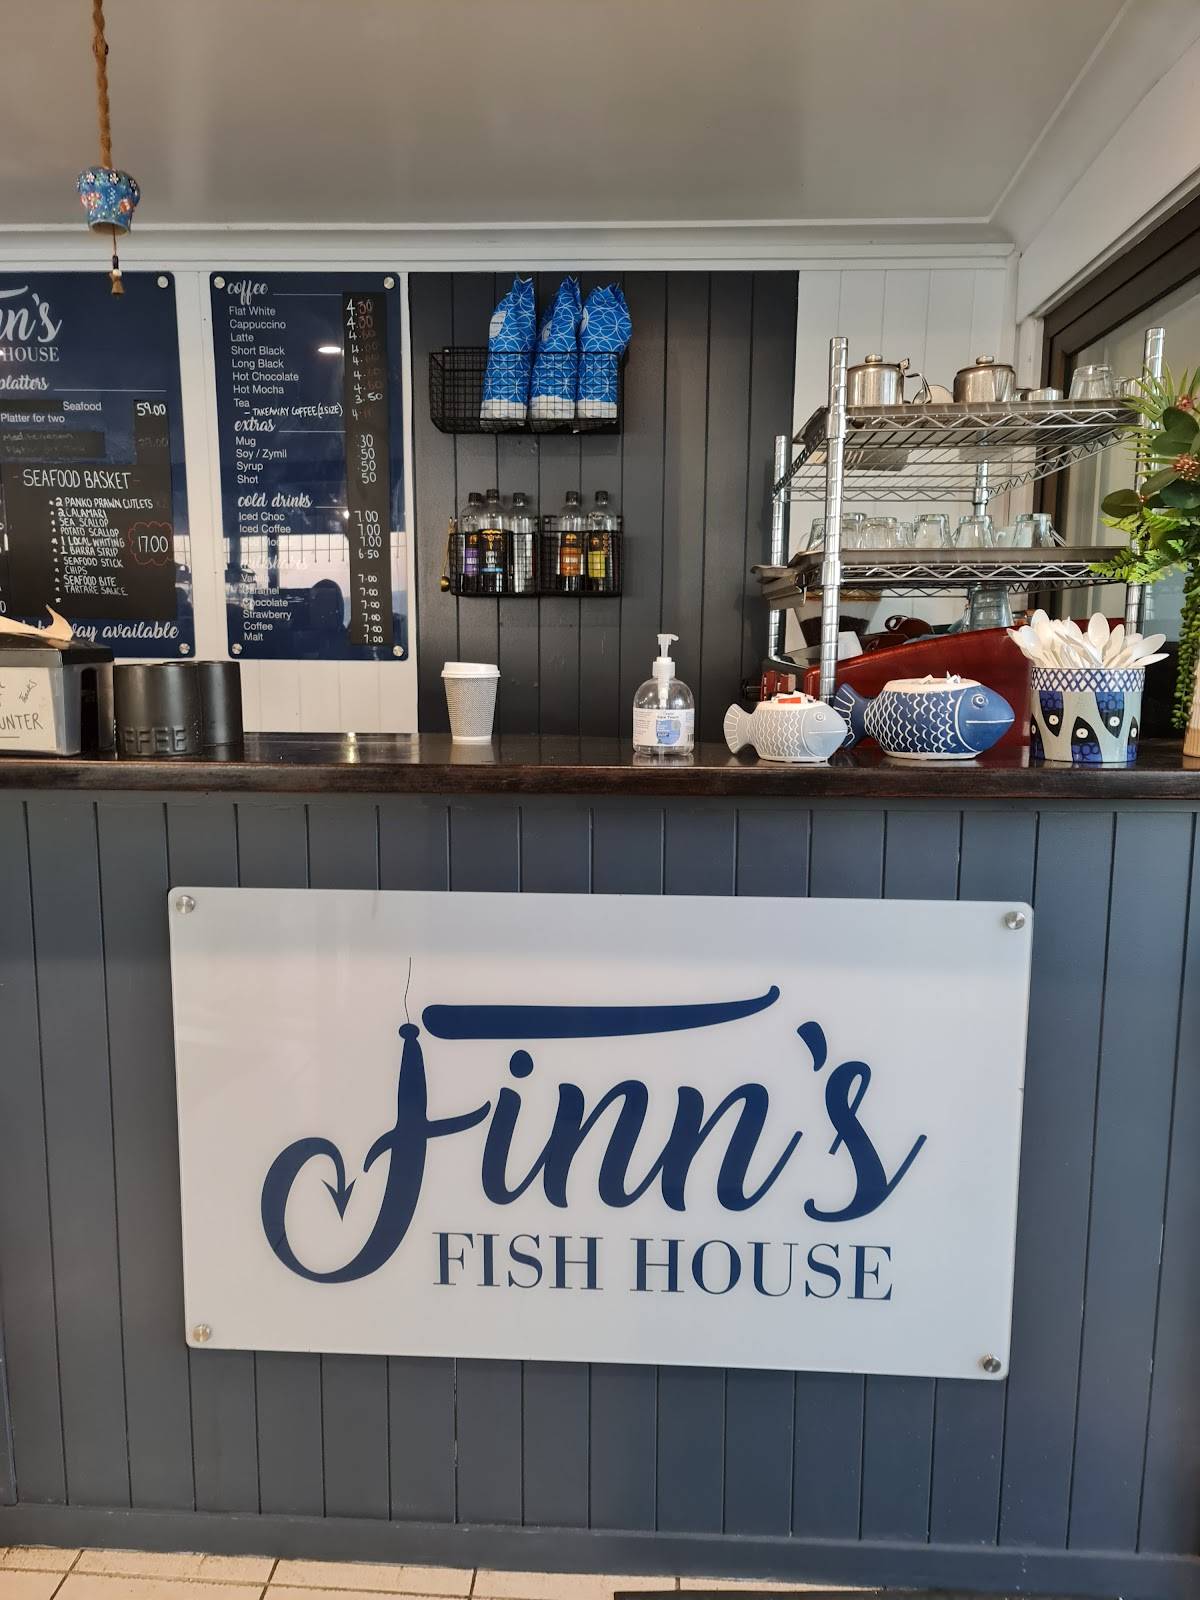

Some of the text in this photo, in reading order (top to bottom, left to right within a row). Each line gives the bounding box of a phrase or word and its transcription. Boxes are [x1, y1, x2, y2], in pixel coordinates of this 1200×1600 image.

[227, 280, 268, 305] coffee
[229, 307, 276, 316] Flat White
[229, 319, 286, 330] Cappuccino
[230, 333, 254, 342] Latte
[2, 346, 60, 362] HOUSE
[231, 346, 285, 355] Short Black
[232, 359, 284, 370] Long Black
[232, 372, 299, 381] Hot Chocolate
[233, 385, 284, 394] Hot Mocha
[63, 401, 102, 411] Seafood
[234, 398, 250, 408] Tea
[136, 403, 166, 416] 59.00
[253, 406, 290, 417] TAKEAWAY
[291, 406, 318, 418] COFFEE
[0, 413, 65, 423] Platter for two
[234, 417, 276, 433] extras
[236, 436, 256, 448] Mug
[236, 449, 254, 460] Soy
[262, 449, 287, 460] Zymil
[236, 461, 264, 472] Syrup
[23, 469, 132, 490] SEAFOOD BASKET
[237, 474, 259, 484] Shot
[55, 497, 154, 510] 2 PANKO PRAWN CUTLETS
[238, 493, 312, 508] cold drinks
[57, 508, 107, 519] 2 CALAMARI
[239, 512, 285, 521] Iced Choc
[59, 518, 109, 528] SEA SCALLOP
[60, 527, 120, 537] POTATO SCALLOP
[240, 524, 291, 534] Iced Coffee
[68, 537, 92, 546] LOCAL
[93, 538, 125, 548] WHITING
[60, 546, 119, 557] 1 BARRA STRIP
[63, 556, 124, 568] SEAFOOD STICK
[65, 565, 88, 575] CHIPS
[63, 575, 117, 587] SEAFOOD BITE
[64, 585, 128, 597] TARTARE SAUCE
[243, 610, 291, 621] Strawberry
[103, 621, 179, 639] available
[244, 622, 273, 631] Coffee
[244, 632, 264, 642] Malt
[260, 985, 927, 1284] Finn's
[432, 1232, 893, 1302] FISH HOUSE
